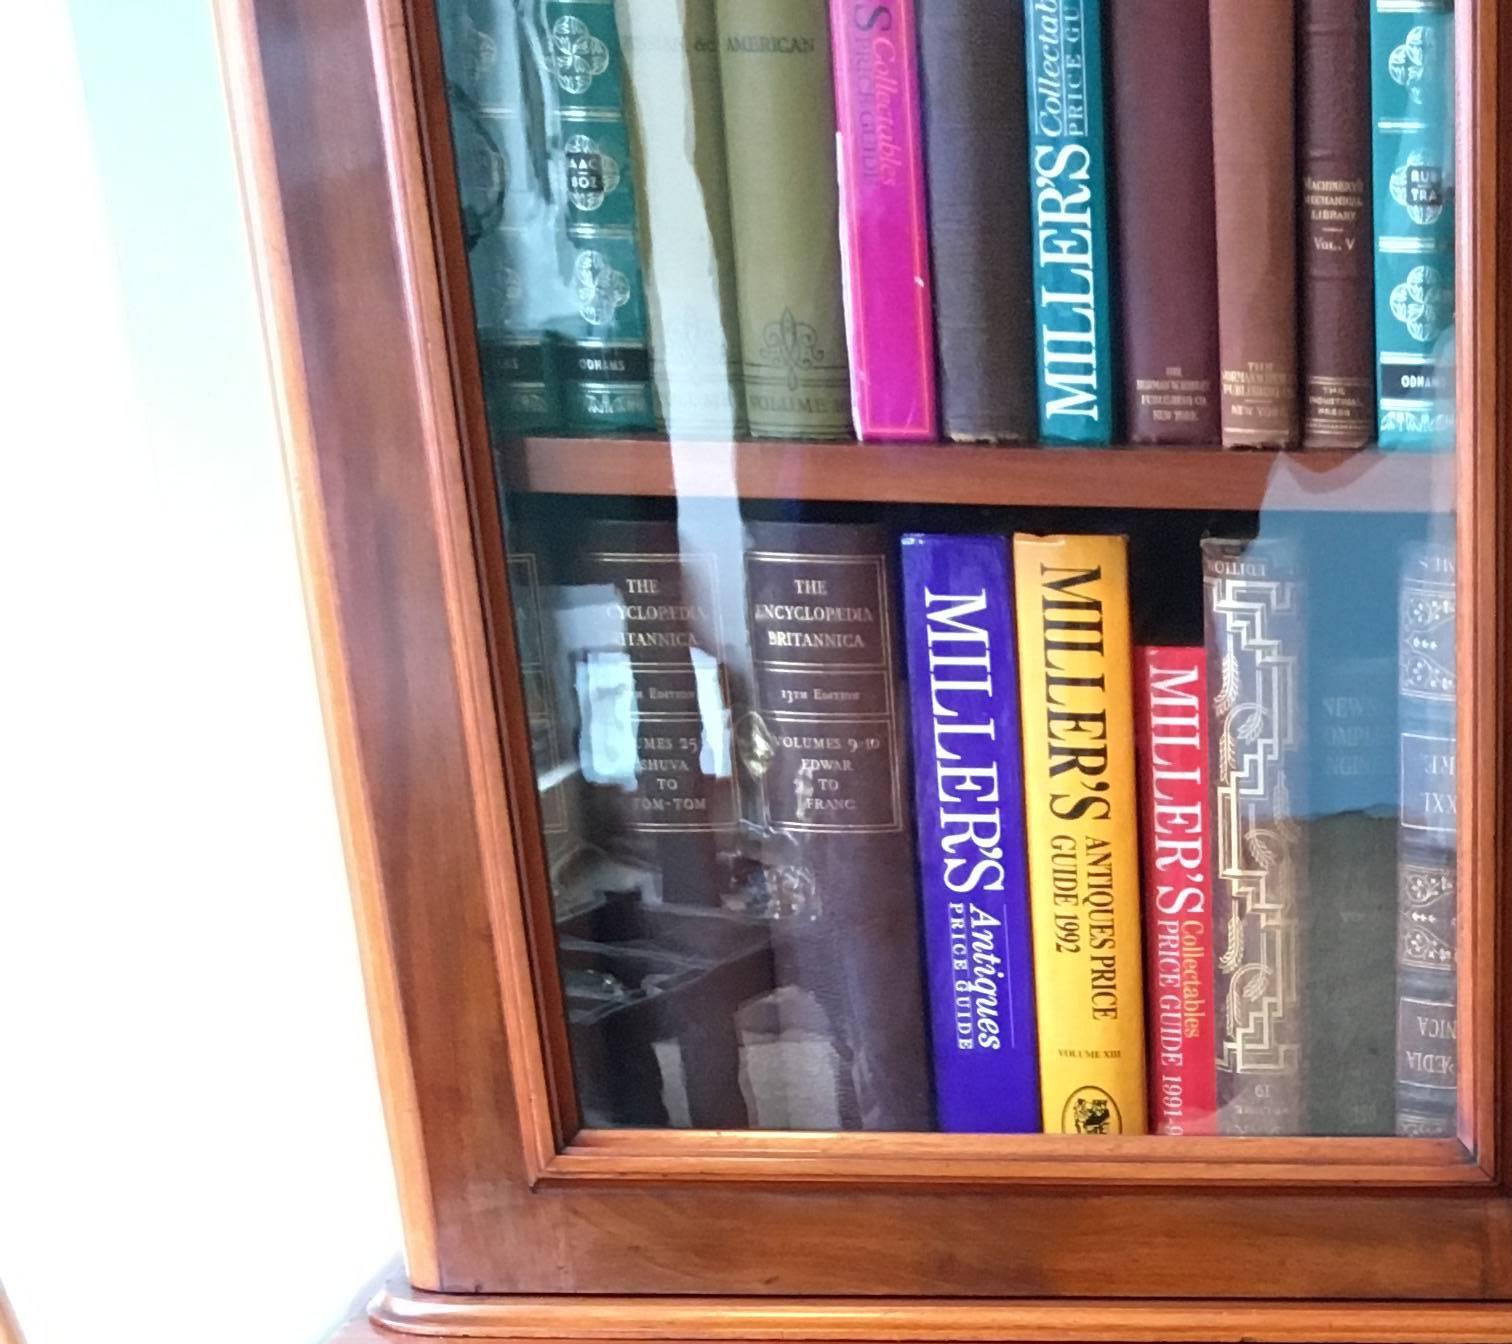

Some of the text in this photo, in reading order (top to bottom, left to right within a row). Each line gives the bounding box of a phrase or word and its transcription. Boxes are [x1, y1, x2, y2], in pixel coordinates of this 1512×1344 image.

[726, 39, 815, 54] AMERICAN
[874, 36, 902, 188] Collectables
[1065, 54, 1084, 137] PRICE
[1034, 144, 1099, 422] MILLER'S
[625, 578, 660, 594] THE
[794, 579, 828, 596] THE
[768, 630, 865, 649] BRITANNICA
[1040, 563, 1111, 821] MILLER'S
[773, 735, 842, 750] VOLUMES
[800, 758, 853, 772] EDWAR
[925, 586, 1005, 893] MILLER'S
[656, 778, 679, 791] TO
[806, 797, 856, 811] FRANC
[817, 777, 839, 792] TO
[1150, 665, 1205, 915] MILLER'S
[1050, 834, 1081, 954] GUIDE 1992
[1082, 835, 1118, 1021] ANTIQUES PRICE
[950, 902, 974, 1050] PRICE GUIDE
[969, 902, 1001, 1050] Antiques
[1157, 919, 1181, 988] PRICE
[1180, 919, 1206, 1039] Collectables
[1058, 1049, 1102, 1059] VOLUME
[1159, 994, 1184, 1067] GUIDE
